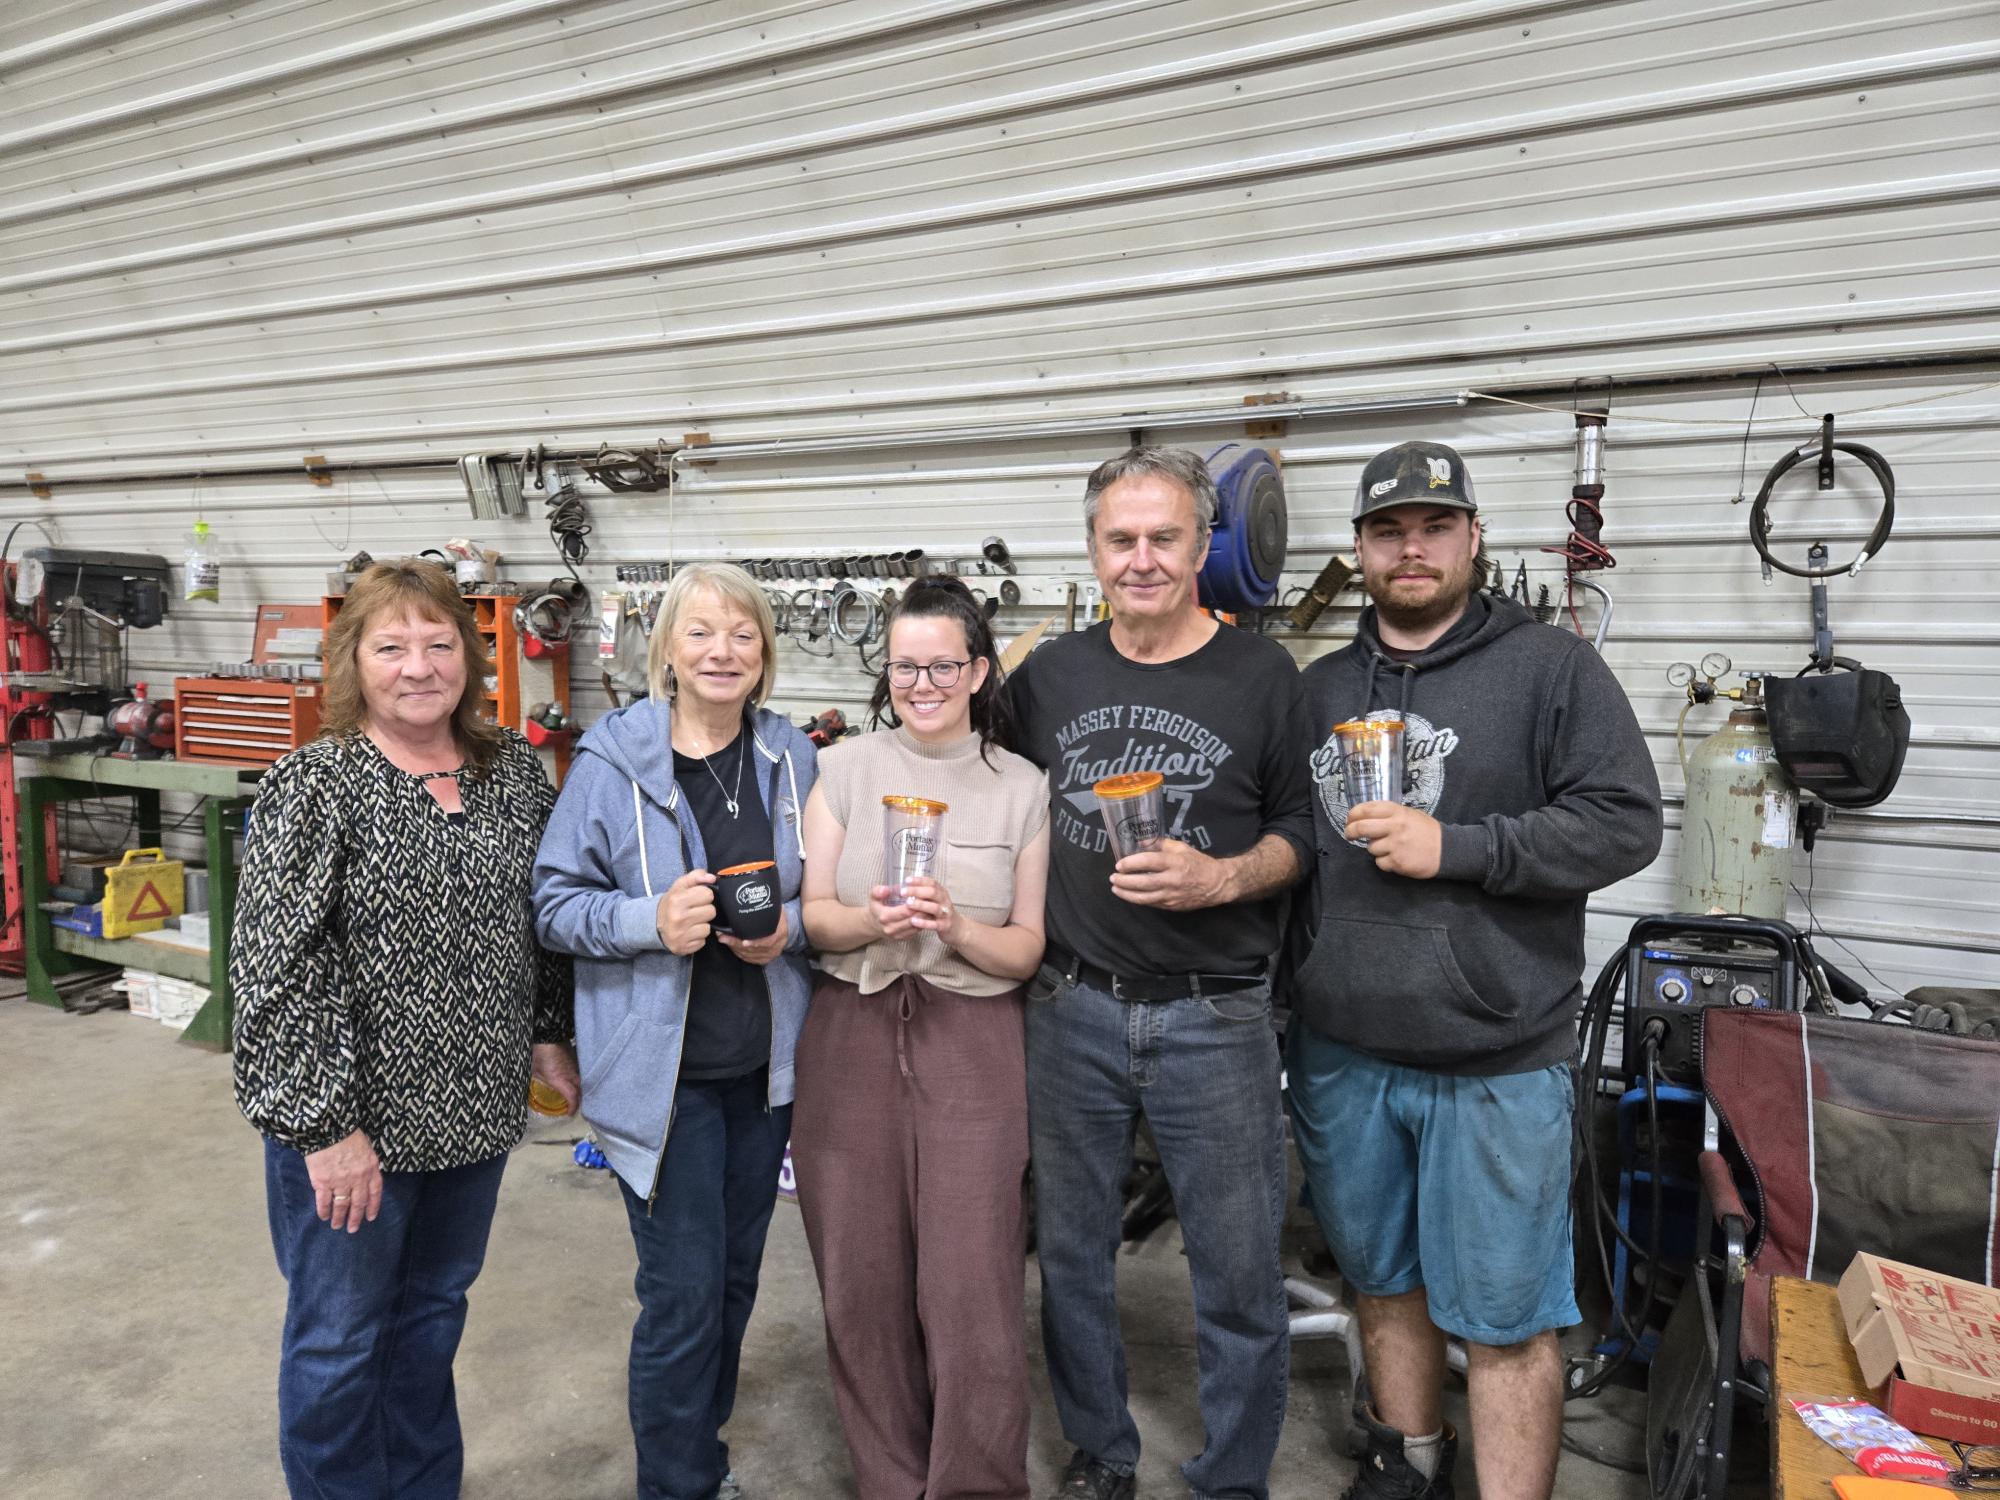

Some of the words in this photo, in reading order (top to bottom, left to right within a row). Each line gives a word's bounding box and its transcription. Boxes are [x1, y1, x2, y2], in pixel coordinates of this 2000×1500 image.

[1055, 705, 1124, 752] MASSEY
[1128, 705, 1233, 767] FERGUSON
[1058, 738, 1214, 790] Tradition
[905, 833, 934, 845] Portage
[1056, 808, 1108, 853] FIELD
[907, 841, 934, 853] Mutual
[1930, 1407, 1968, 1422] Cheers
[1969, 1416, 1981, 1425] to
